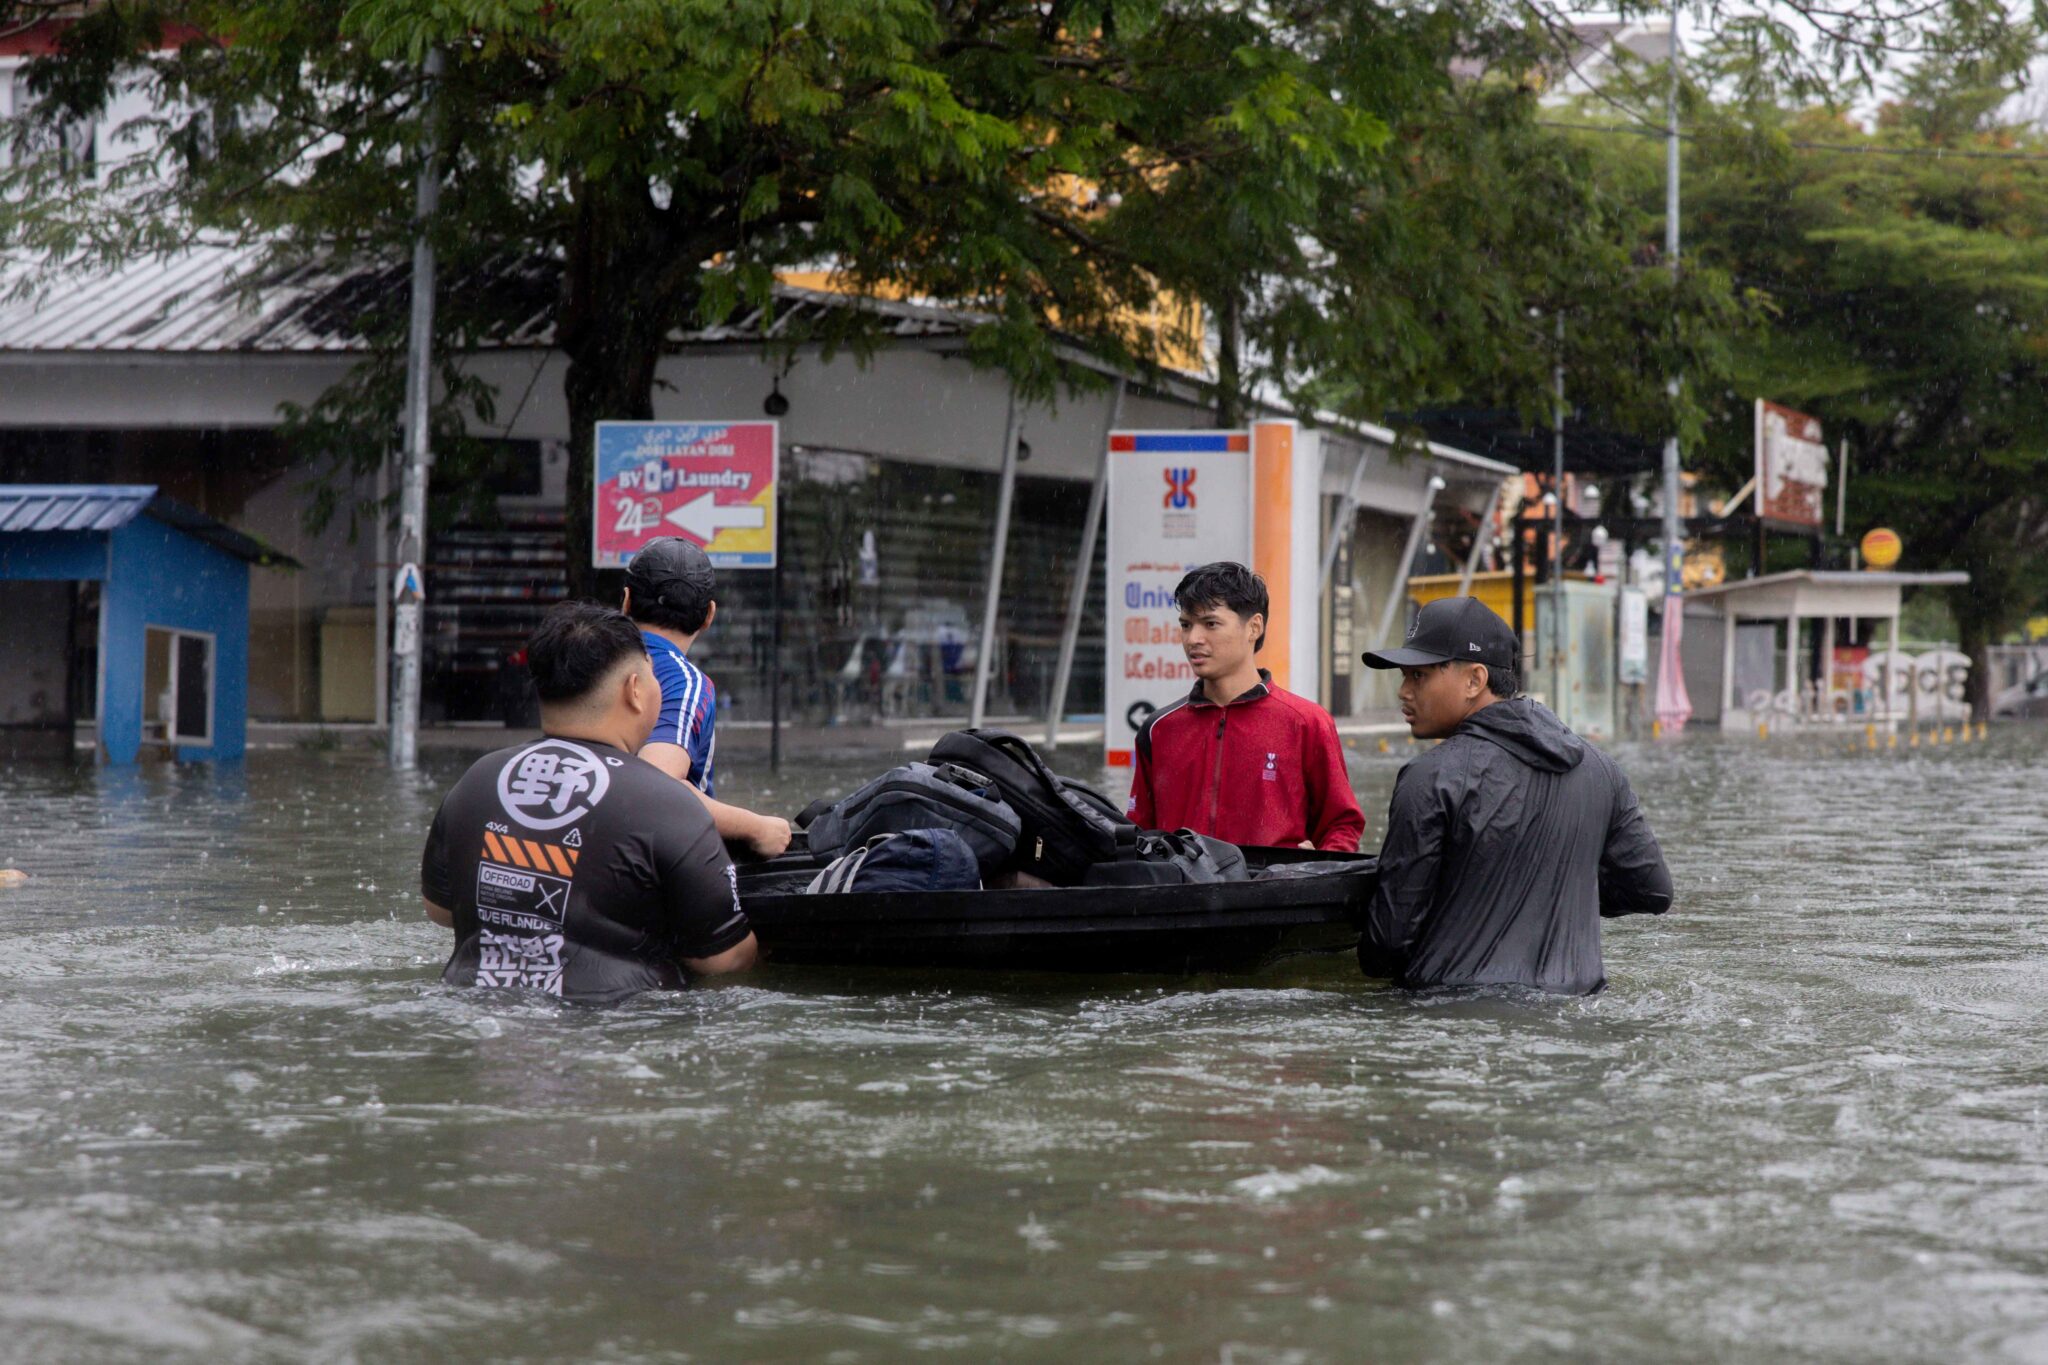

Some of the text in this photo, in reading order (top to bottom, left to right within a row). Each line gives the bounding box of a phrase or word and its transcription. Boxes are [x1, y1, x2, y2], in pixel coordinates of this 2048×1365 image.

[678, 468, 752, 490] Laundry
[483, 870, 532, 889] OFFROAD
[478, 908, 565, 934] OVERLANDE
